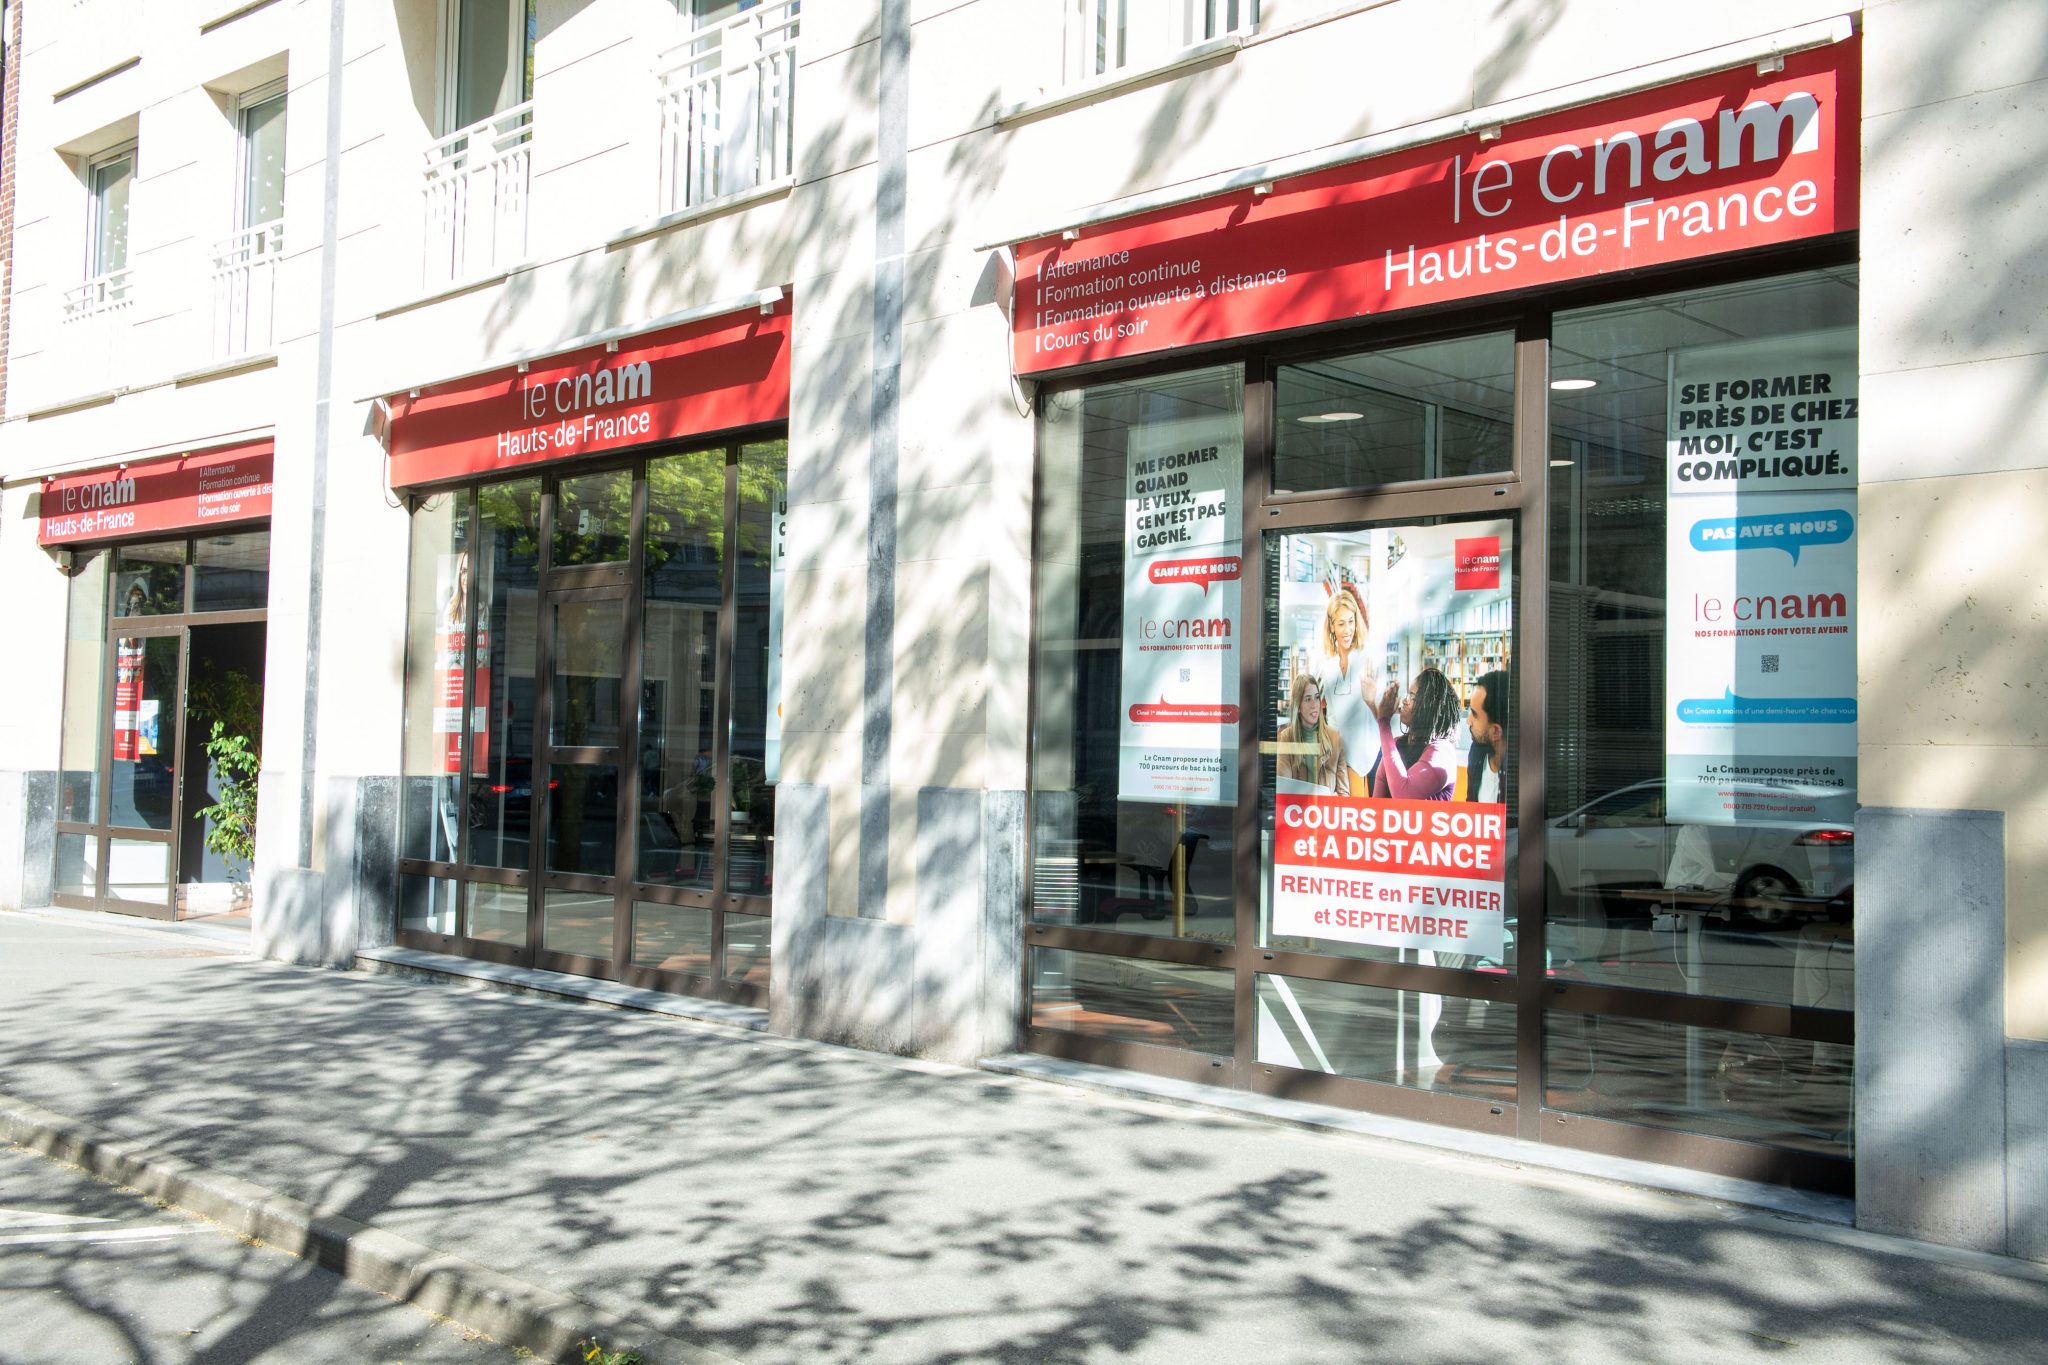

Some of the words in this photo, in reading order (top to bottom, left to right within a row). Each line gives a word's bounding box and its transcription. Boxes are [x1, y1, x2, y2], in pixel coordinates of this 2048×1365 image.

[1453, 154, 1513, 224] le
[1539, 91, 1819, 204] cnam
[1384, 178, 1818, 290] Hauts-de-France
[1045, 250, 1130, 281] Alternance
[1045, 275, 1124, 305] Formation
[1128, 259, 1200, 287] continue
[1044, 298, 1124, 328] Formation
[1128, 284, 1191, 311] ouverte
[1196, 280, 1206, 299] à
[1210, 268, 1287, 296] distance
[1044, 328, 1090, 351] Cours
[1093, 324, 1114, 342] du
[1117, 318, 1148, 338] soir
[523, 377, 546, 420] le
[555, 360, 652, 414] cnam
[1680, 383, 1710, 405] SE
[1715, 373, 1832, 402] FORMER
[1679, 404, 1746, 431] PRÈS
[1751, 403, 1785, 426] DE
[1791, 398, 1859, 423] CHEZ
[497, 411, 650, 458] Hauts-de-France
[1678, 433, 1742, 457] MOI,
[1748, 428, 1823, 452] C'EST
[203, 464, 236, 478] Alternance
[1135, 458, 1156, 476] ME
[1158, 446, 1218, 472] FORMER
[1677, 449, 1848, 482] COMPLIQUÉ.
[62, 483, 76, 512] le
[80, 477, 136, 509] cnam
[202, 491, 233, 504] Formation
[233, 487, 256, 499] ouverte
[203, 478, 233, 491] Formation
[233, 473, 260, 485] continue
[1135, 472, 1188, 494] QUAND
[201, 506, 220, 518] Cours
[220, 504, 229, 514] du
[229, 502, 241, 513] soir
[1136, 497, 1150, 512] JE
[1152, 489, 1196, 509] VEUX,
[46, 511, 135, 538] Hauts-de-France
[1136, 515, 1152, 530] CE
[1155, 508, 1194, 527] N'EST
[1198, 502, 1226, 520] PAS
[1702, 527, 1736, 541] PAS
[1739, 523, 1784, 538] AVEC
[1789, 520, 1838, 535] NOUS
[1136, 525, 1192, 549] GAGNÉ.
[1154, 566, 1180, 578] SAUF
[1180, 564, 1208, 576] AVEC
[1210, 562, 1238, 574] NOUS
[1462, 556, 1470, 564] le
[1472, 555, 1499, 564] cnam
[1695, 593, 1722, 622] le
[1733, 592, 1846, 621] cnam
[1139, 616, 1157, 640] le
[1162, 618, 1232, 639] cnam
[1695, 630, 1712, 638] NOS
[1713, 628, 1766, 637] FORMATIONS
[1767, 628, 1788, 636] FONT
[1790, 627, 1816, 635] VOTRE
[1818, 626, 1848, 634] AVENIR
[1698, 776, 1716, 784] 700
[1718, 777, 1764, 785] parcours
[1766, 778, 1779, 786] de
[1781, 778, 1800, 786] bac
[1802, 777, 1809, 786] à
[1812, 778, 1844, 787] bac+8
[1706, 765, 1718, 773] Le
[1720, 765, 1750, 774] Cnam
[1752, 767, 1794, 776] propose
[1797, 767, 1820, 776] près
[1823, 767, 1836, 776] de
[1284, 804, 1376, 832] COURS
[1383, 809, 1422, 835] DU
[1430, 811, 1501, 840] SOIR
[1293, 835, 1318, 857] et
[1322, 835, 1340, 859] A
[1346, 836, 1492, 870] DISTANCE
[1280, 875, 1373, 900] RENTREE
[1378, 886, 1402, 903] en
[1408, 885, 1501, 912] FEVRIER
[1314, 908, 1330, 926] et
[1335, 908, 1469, 939] SEPTEMBRE
